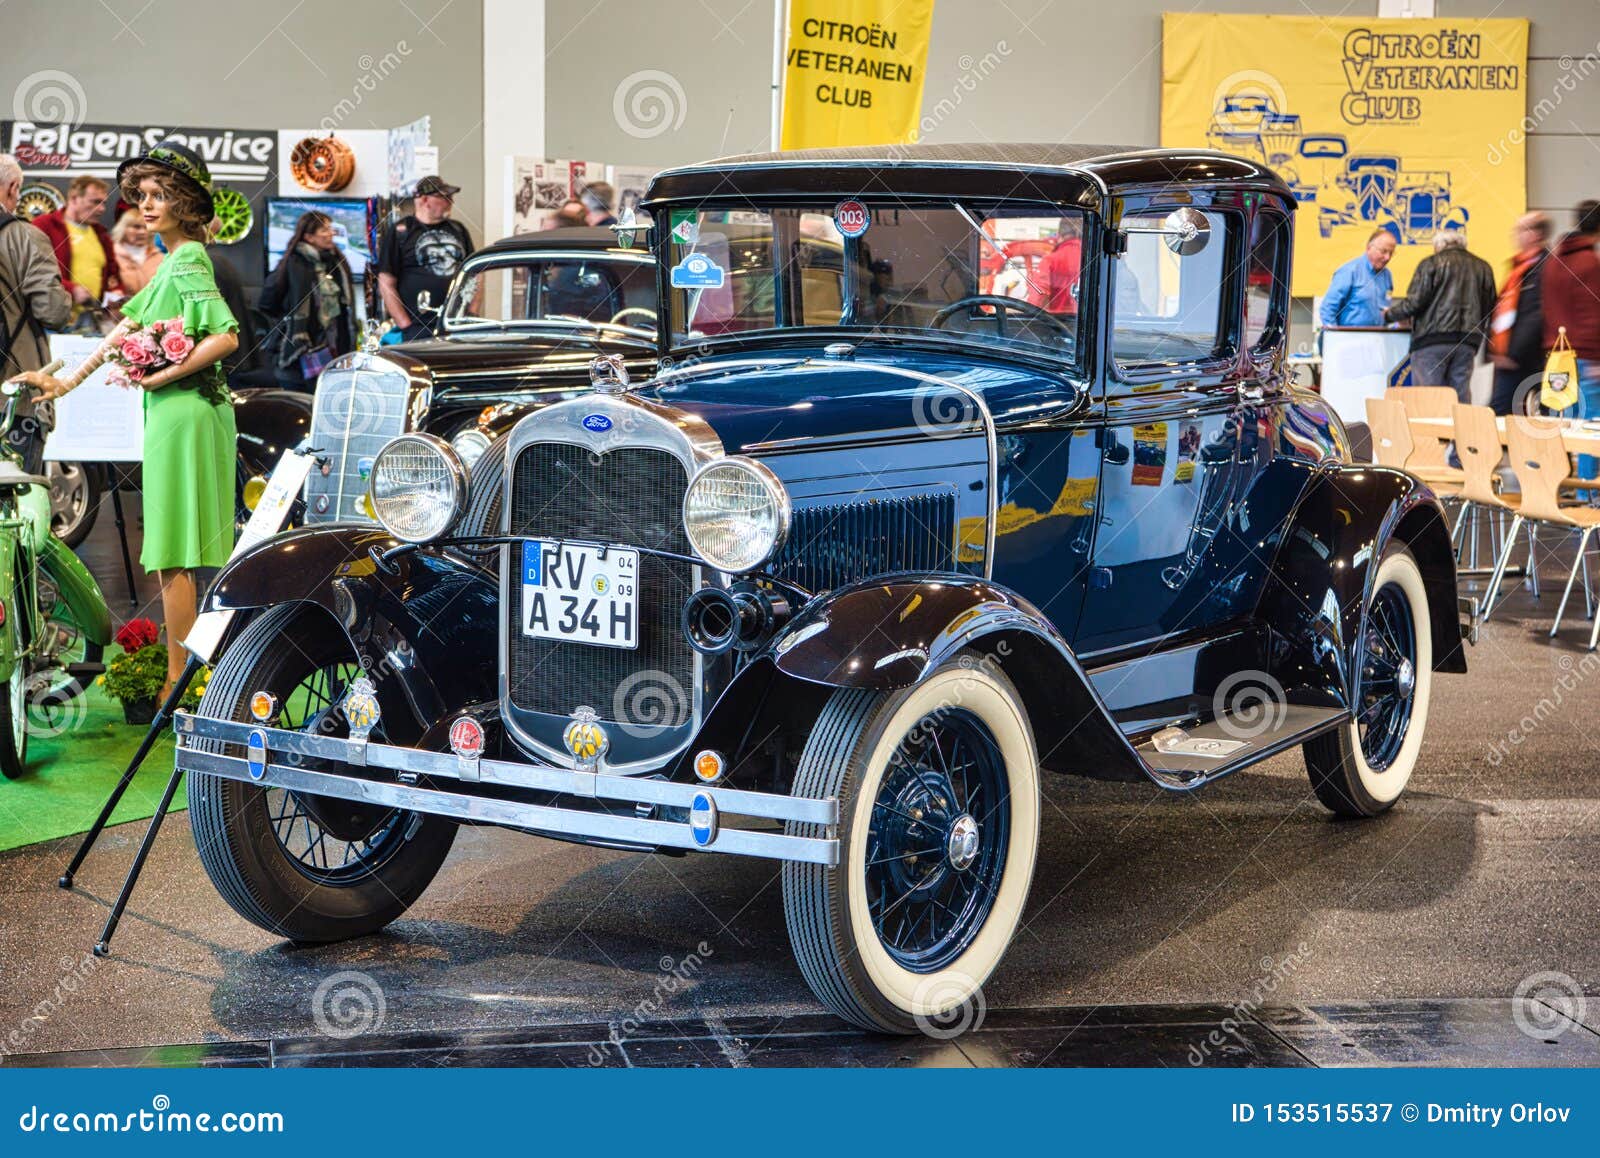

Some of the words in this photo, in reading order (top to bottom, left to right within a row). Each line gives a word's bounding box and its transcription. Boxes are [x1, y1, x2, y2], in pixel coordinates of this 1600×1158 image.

[803, 18, 897, 50] CITROËN
[1343, 28, 1481, 61] CITROËN
[1342, 58, 1518, 94] VETERANEN
[816, 84, 872, 109] CLUB
[1340, 90, 1421, 126] CLUB
[839, 209, 864, 225] 003
[585, 415, 610, 429] Ford
[528, 568, 536, 580] D
[541, 549, 586, 591] RV
[618, 556, 633, 569] 04
[617, 584, 633, 597] 09
[529, 592, 549, 632] A
